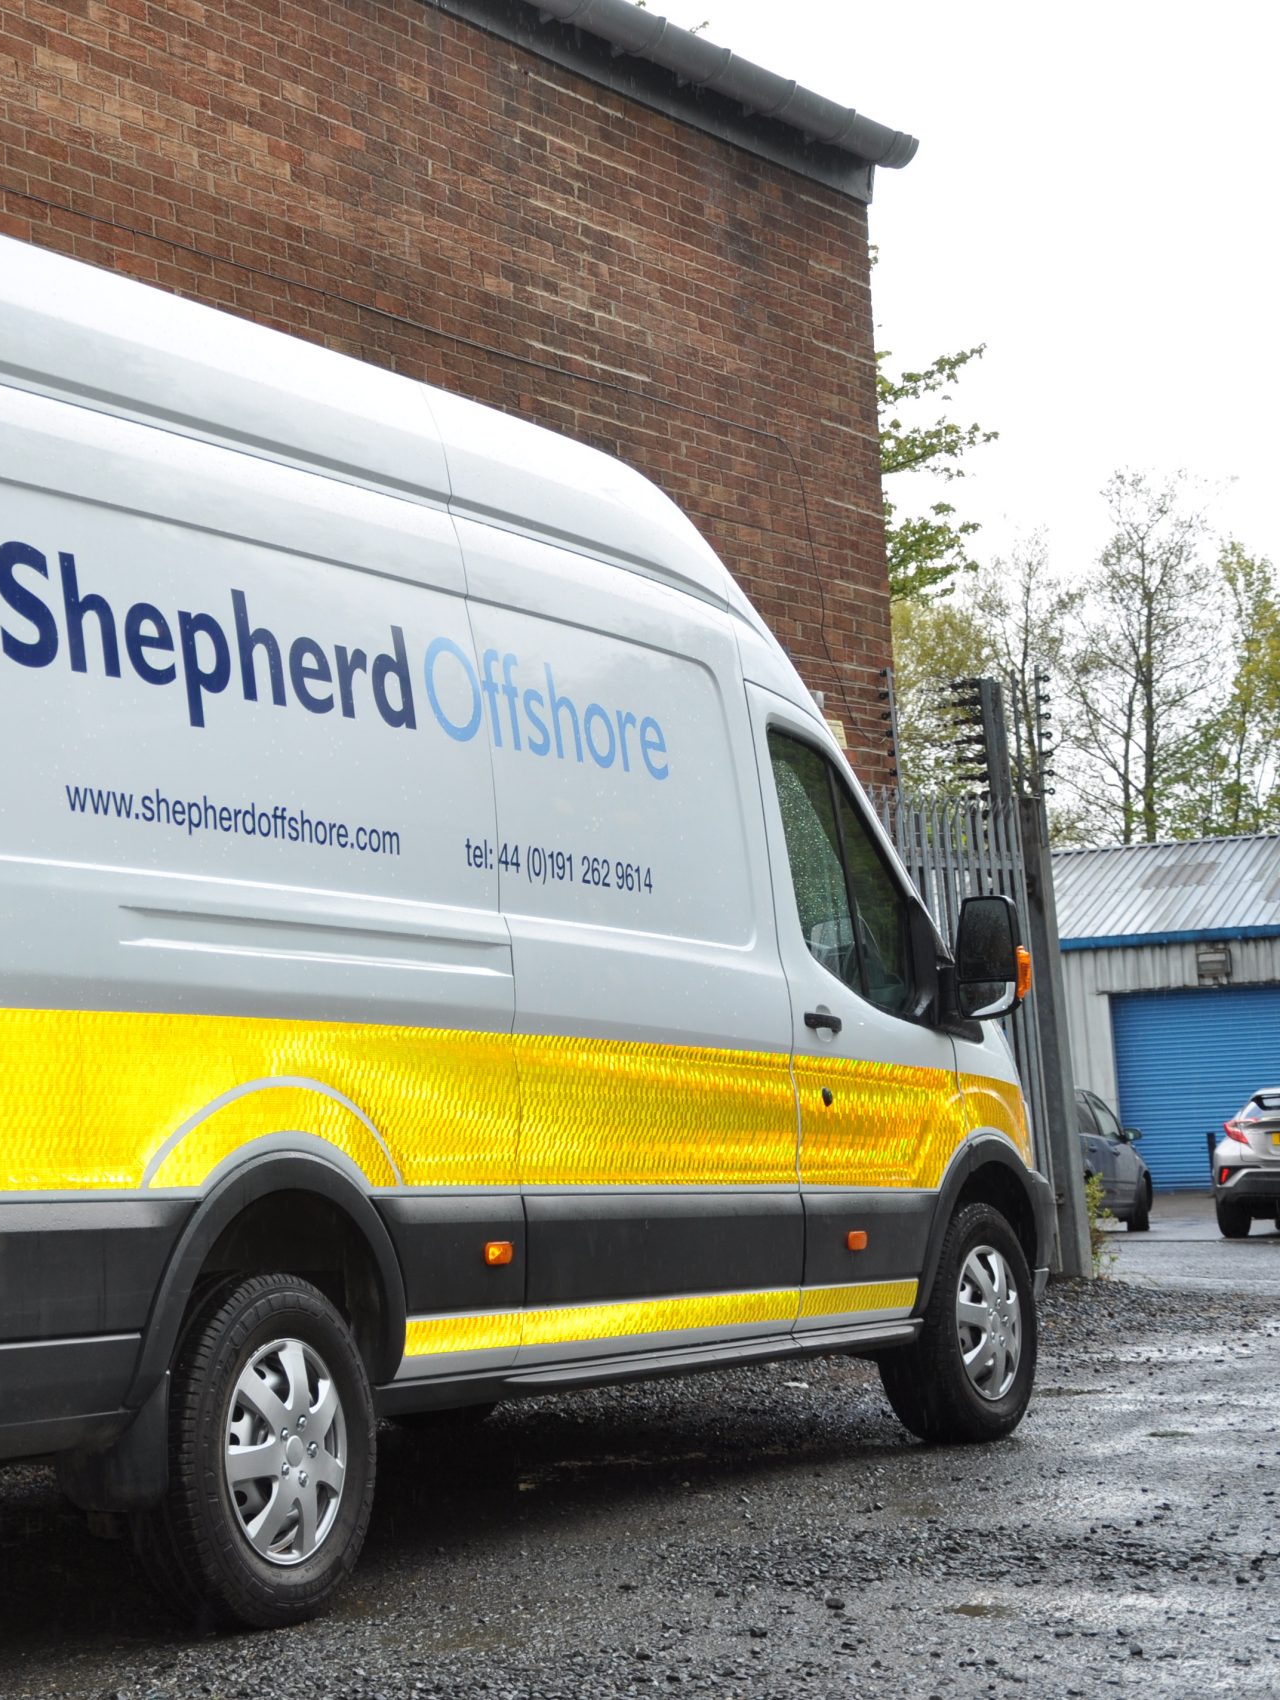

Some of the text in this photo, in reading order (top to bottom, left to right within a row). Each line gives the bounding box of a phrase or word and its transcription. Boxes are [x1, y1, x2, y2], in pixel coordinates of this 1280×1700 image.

[424, 636, 669, 780] Offshore
[65, 785, 401, 855] www.shepherdoffshore.com
[465, 838, 653, 894] tel: 44 (0)191 262 9614
